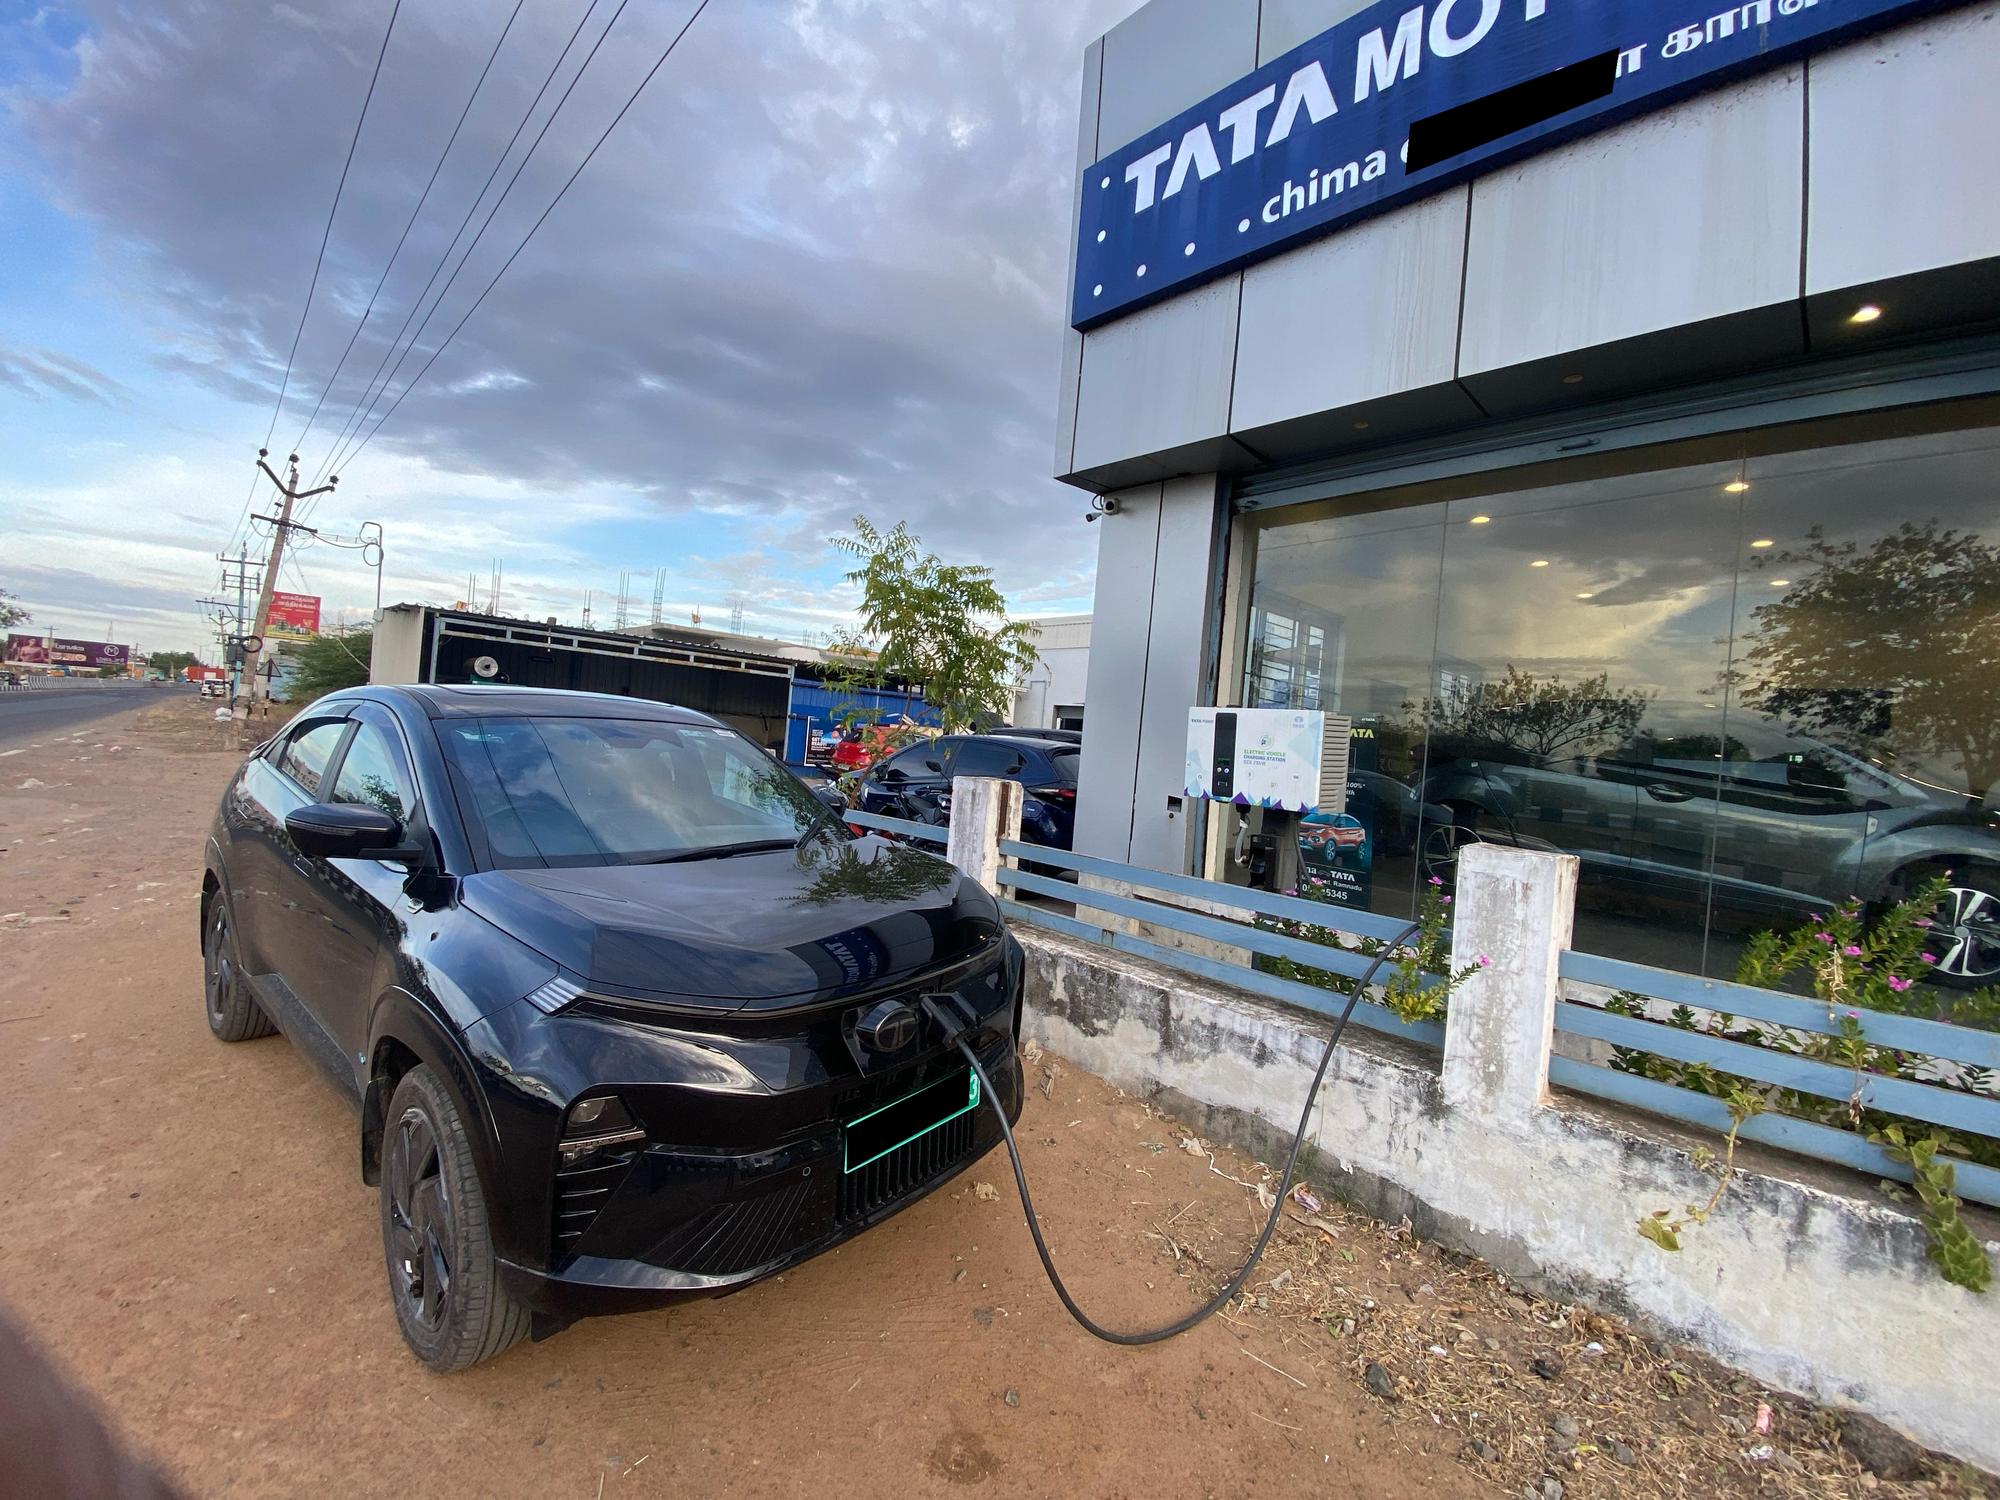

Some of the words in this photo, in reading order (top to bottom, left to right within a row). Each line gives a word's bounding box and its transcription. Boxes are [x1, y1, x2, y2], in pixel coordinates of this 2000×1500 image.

[1125, 60, 1339, 214] TATA
[1262, 149, 1387, 224] chima
[1349, 728, 1374, 739] ATA
[1330, 870, 1356, 882] TATA
